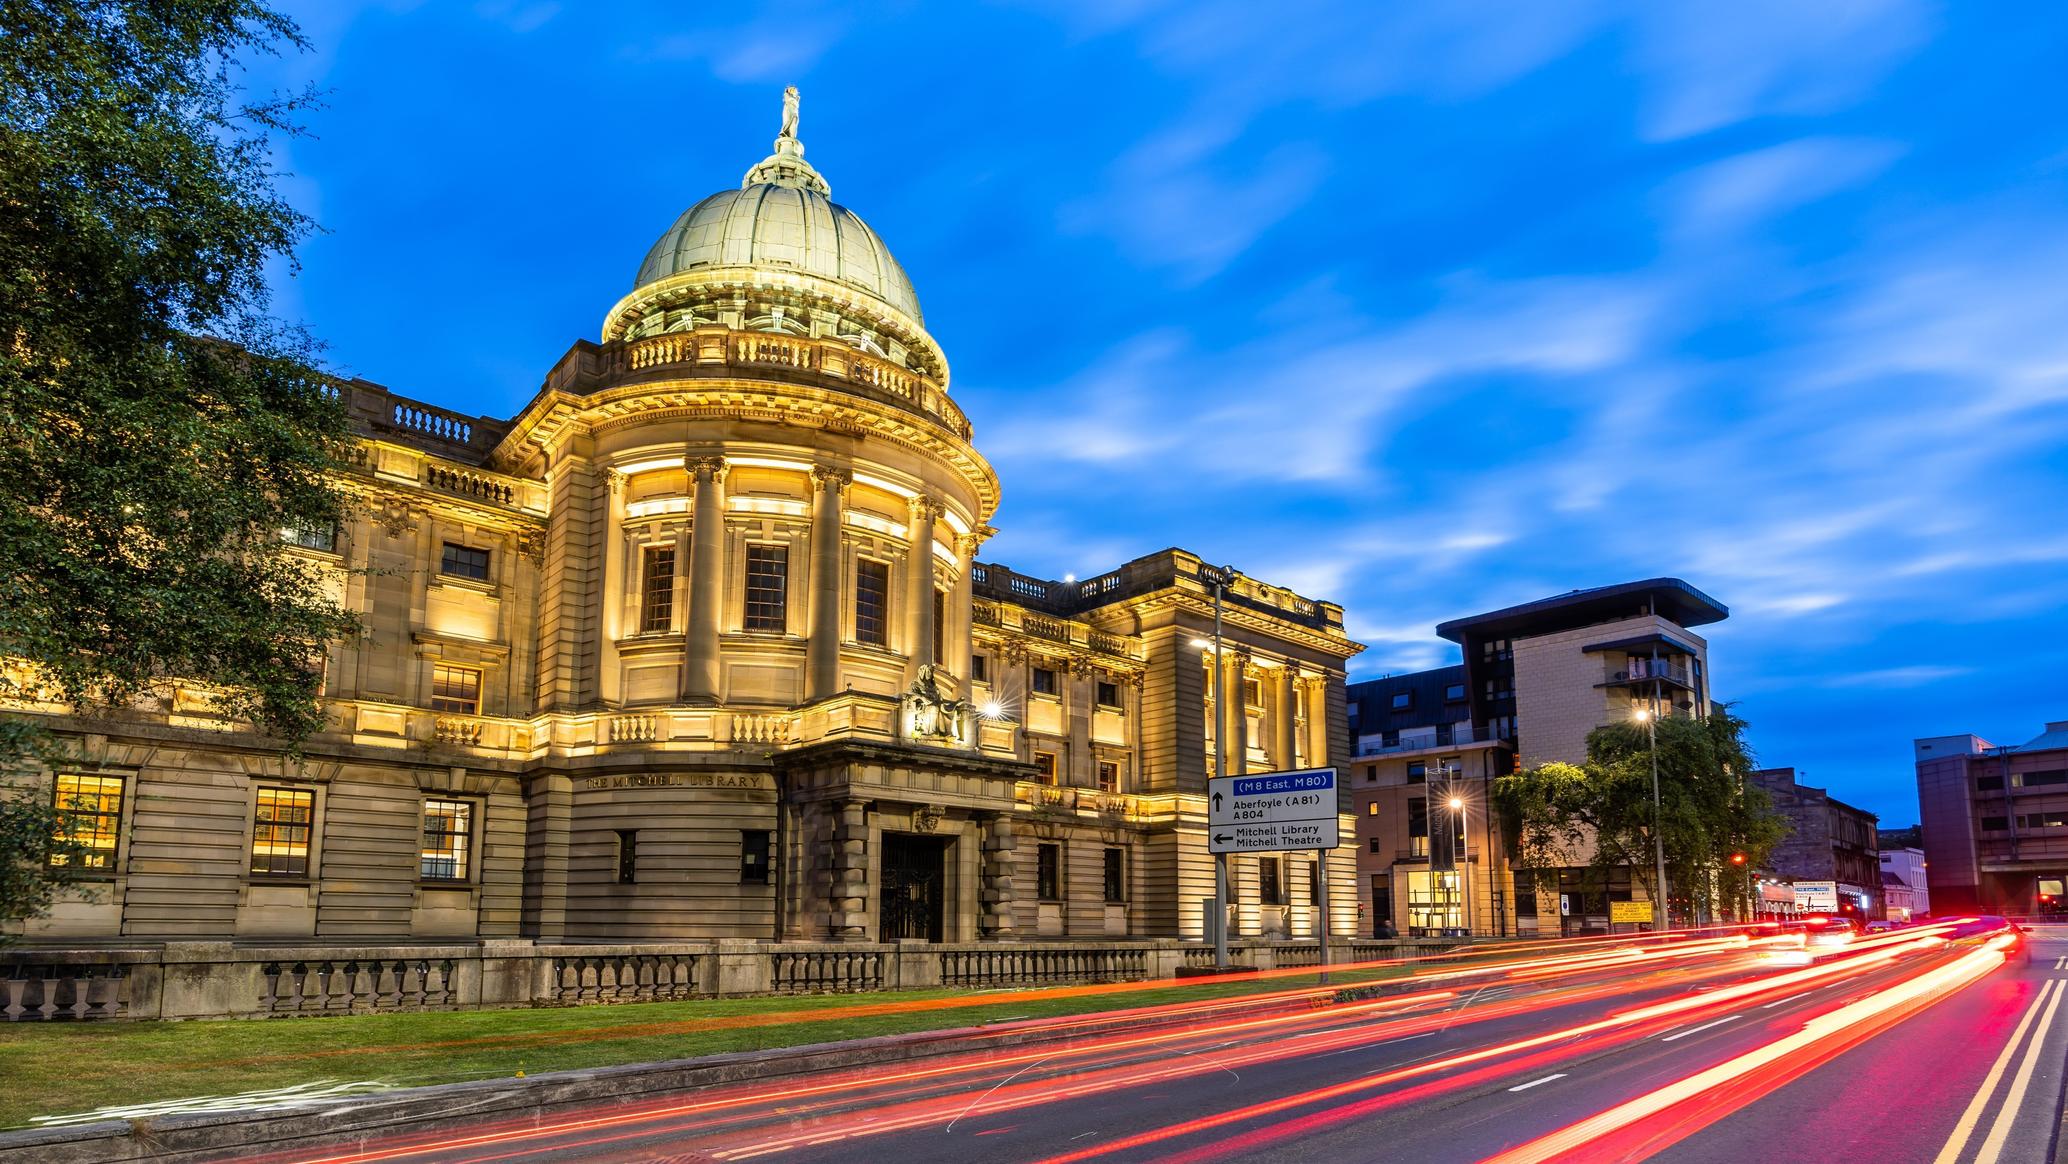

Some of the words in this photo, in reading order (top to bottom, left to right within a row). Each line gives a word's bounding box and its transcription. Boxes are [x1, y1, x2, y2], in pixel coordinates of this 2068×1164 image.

[586, 778, 608, 789] THE
[613, 775, 683, 788] MITCHELL
[690, 775, 761, 787] LIBRARY
[1233, 799, 1282, 810] Aberfoyle
[1236, 827, 1277, 837] Mitchell
[1282, 825, 1319, 835] Library
[1236, 837, 1277, 847] Mitchell
[1282, 836, 1322, 846] Theatre
